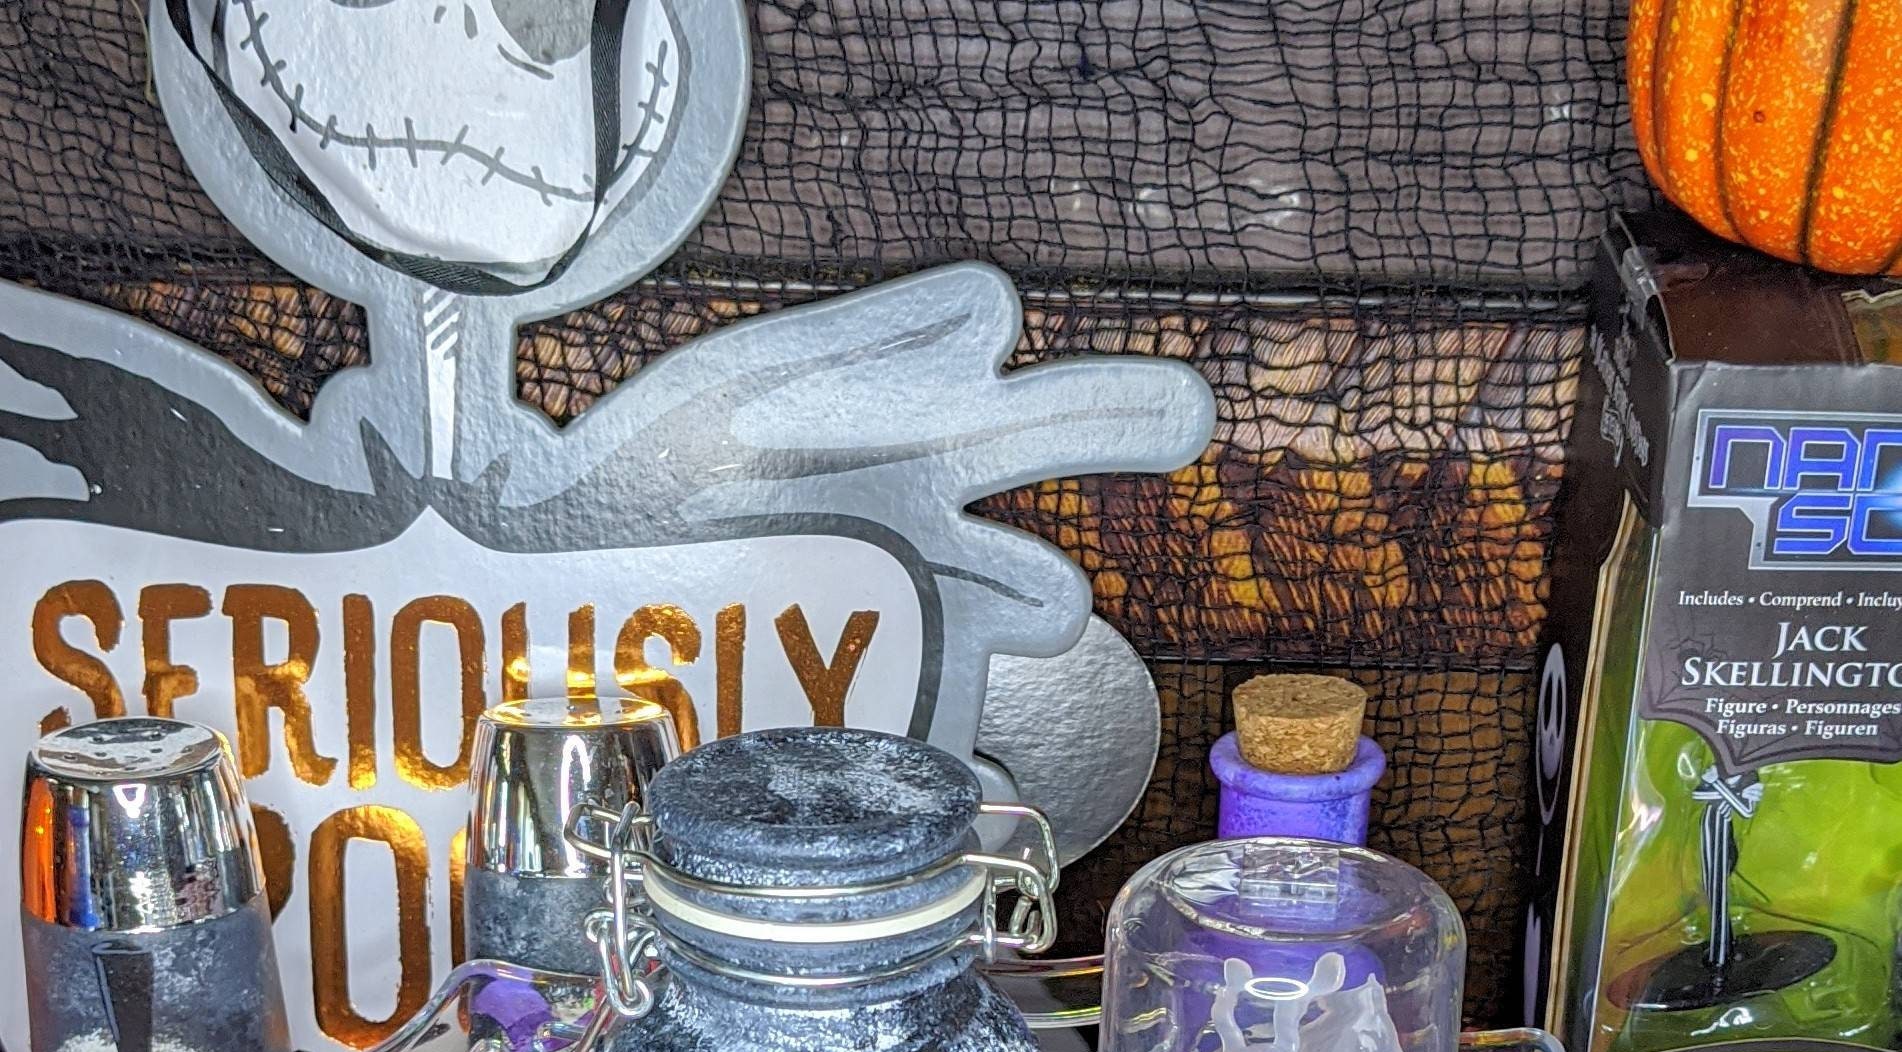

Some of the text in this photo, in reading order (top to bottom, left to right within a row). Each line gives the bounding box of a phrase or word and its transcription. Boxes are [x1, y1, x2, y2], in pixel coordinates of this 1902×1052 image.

[1678, 590, 1744, 606] Includes
[1759, 591, 1843, 611] Comprend
[1771, 621, 1869, 660] JACK
[1704, 697, 1902, 719] Figure Personnages
[1716, 719, 1878, 740] Figuras Figuren
